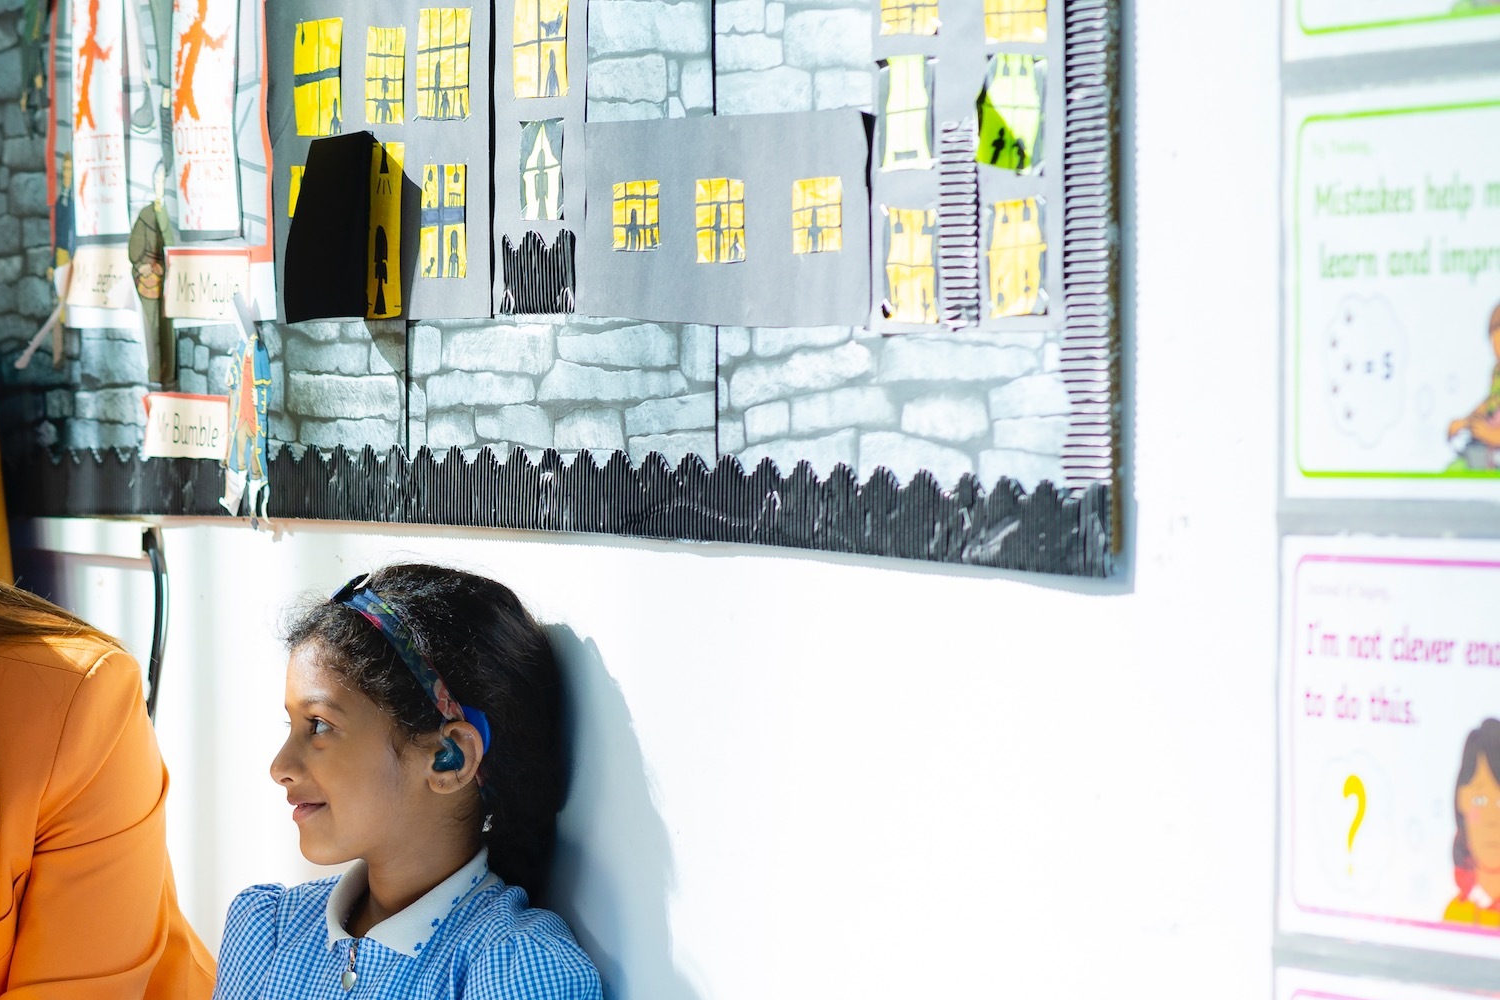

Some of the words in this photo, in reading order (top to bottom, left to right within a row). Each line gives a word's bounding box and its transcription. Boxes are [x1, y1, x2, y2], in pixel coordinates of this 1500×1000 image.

[1313, 174, 1416, 217] Mistakes
[1424, 170, 1475, 221] help
[1318, 240, 1378, 281] learn
[1387, 235, 1431, 277] and
[1440, 235, 1500, 287] impr
[176, 271, 196, 303] Mrs
[199, 271, 240, 316] Maylie
[173, 411, 219, 448] Bumble
[1306, 621, 1340, 657] I'm
[1348, 629, 1382, 662] not
[1391, 625, 1456, 665] clever
[1304, 688, 1325, 720] to
[1335, 683, 1361, 721] do
